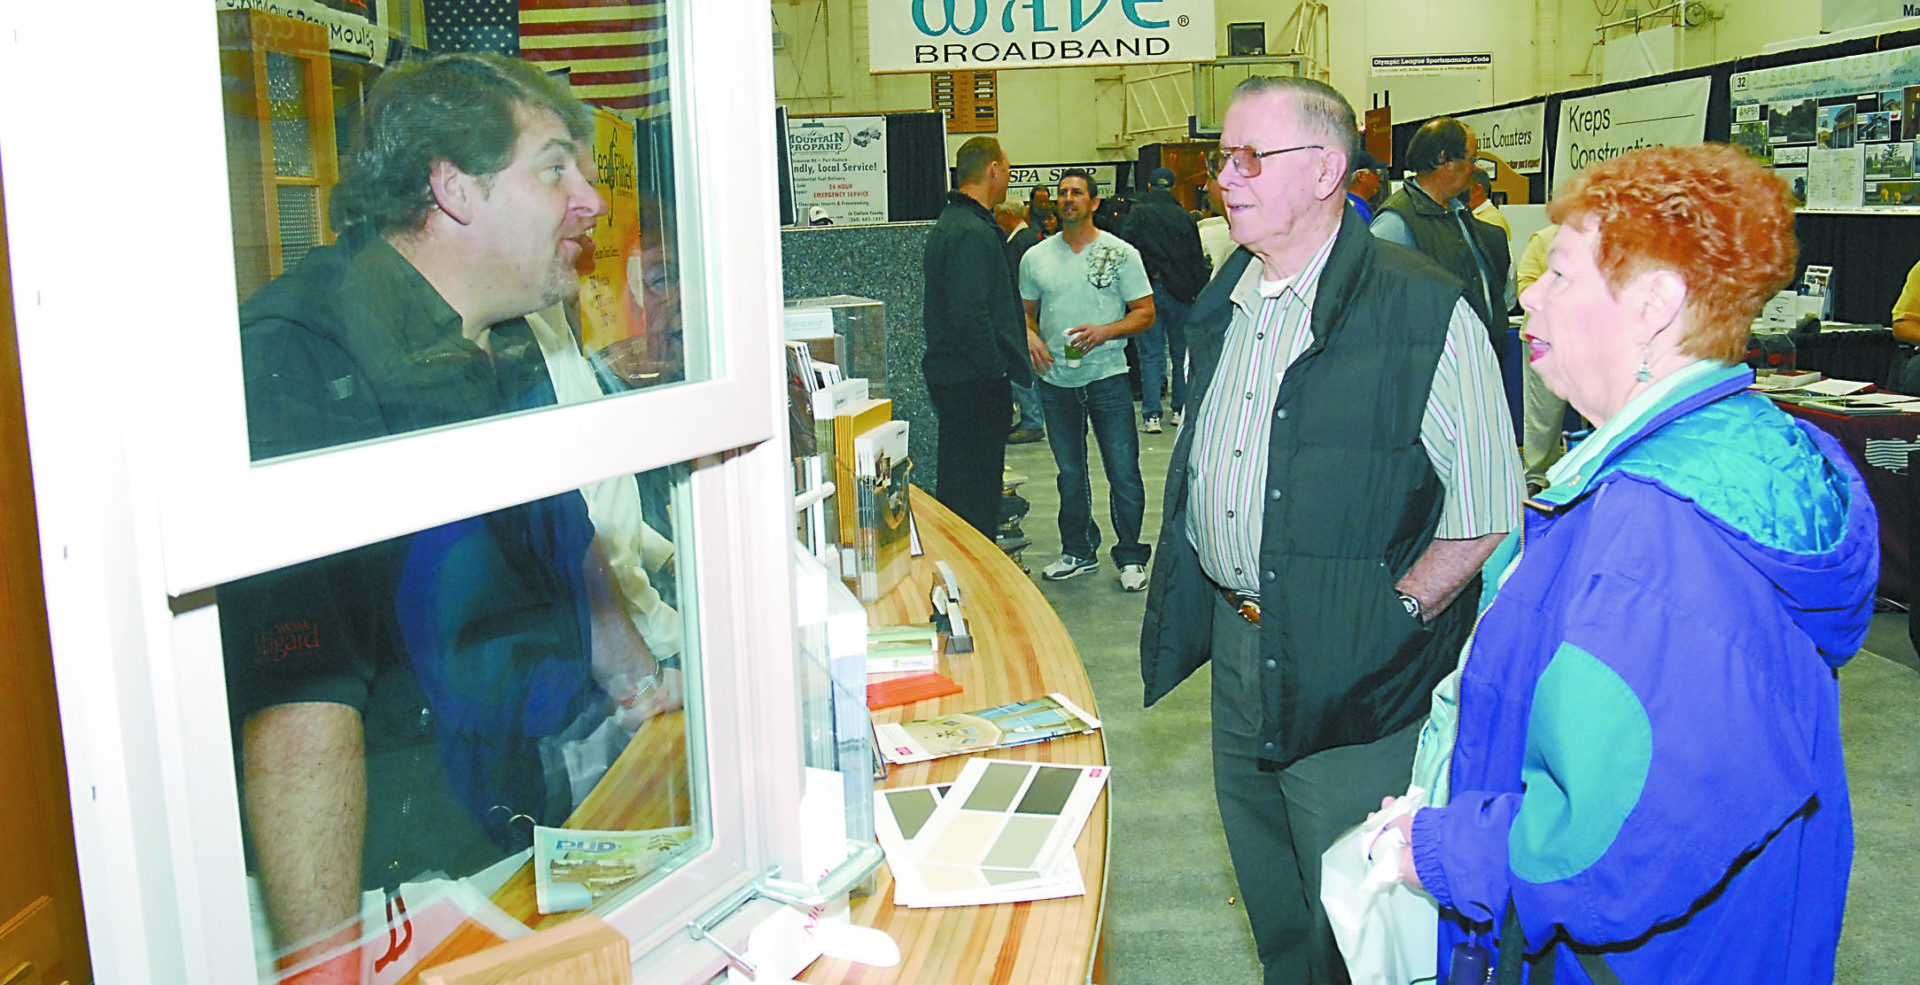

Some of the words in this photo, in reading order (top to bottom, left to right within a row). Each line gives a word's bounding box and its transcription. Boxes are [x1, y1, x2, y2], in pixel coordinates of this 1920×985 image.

[915, 38, 1171, 63] BROADBAND
[1401, 58, 1425, 66] League
[1841, 49, 1912, 71] CUSTOM
[1736, 77, 1746, 88] 32
[1569, 105, 1611, 137] Kreps
[1482, 133, 1491, 149] in
[1492, 124, 1532, 148] Counters
[790, 143, 842, 151] PROPANE
[818, 163, 840, 173] Local
[842, 162, 877, 172] Service!
[1009, 169, 1040, 183] SPA
[1049, 167, 1097, 182] SP
[555, 840, 617, 853] PUD
